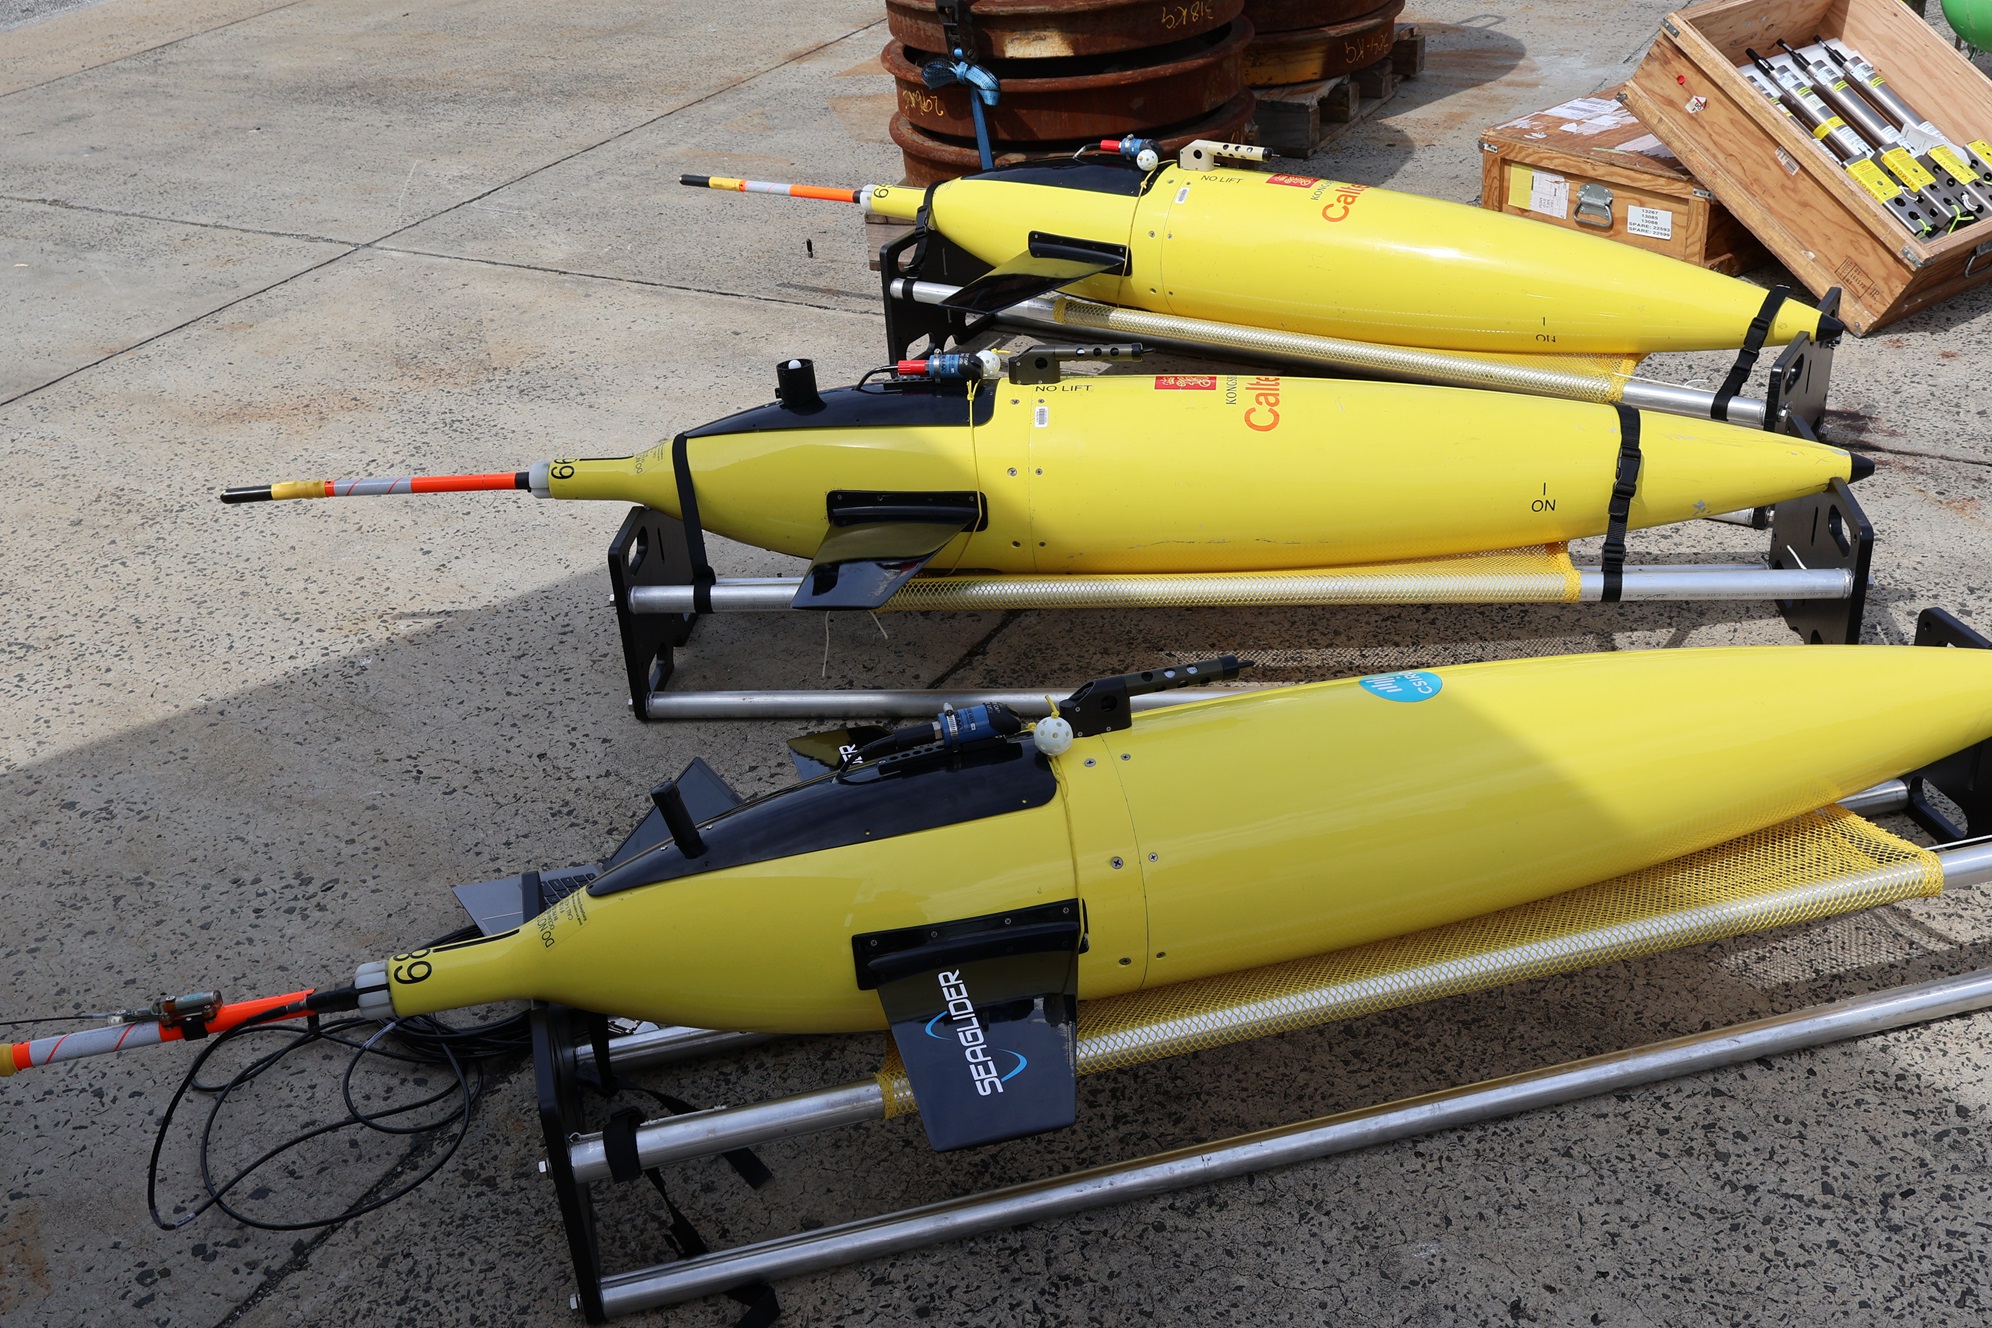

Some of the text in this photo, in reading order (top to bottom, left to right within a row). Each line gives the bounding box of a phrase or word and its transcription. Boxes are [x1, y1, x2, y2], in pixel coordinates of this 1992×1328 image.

[1201, 174, 1244, 184] NO LIFT
[1891, 163, 1916, 187] REMOVE
[1061, 384, 1093, 392] LIFT
[1531, 499, 1556, 513] ON
[541, 930, 555, 948] DO
[393, 949, 433, 984] 68
[938, 968, 1004, 1096] SEAGLIDER
